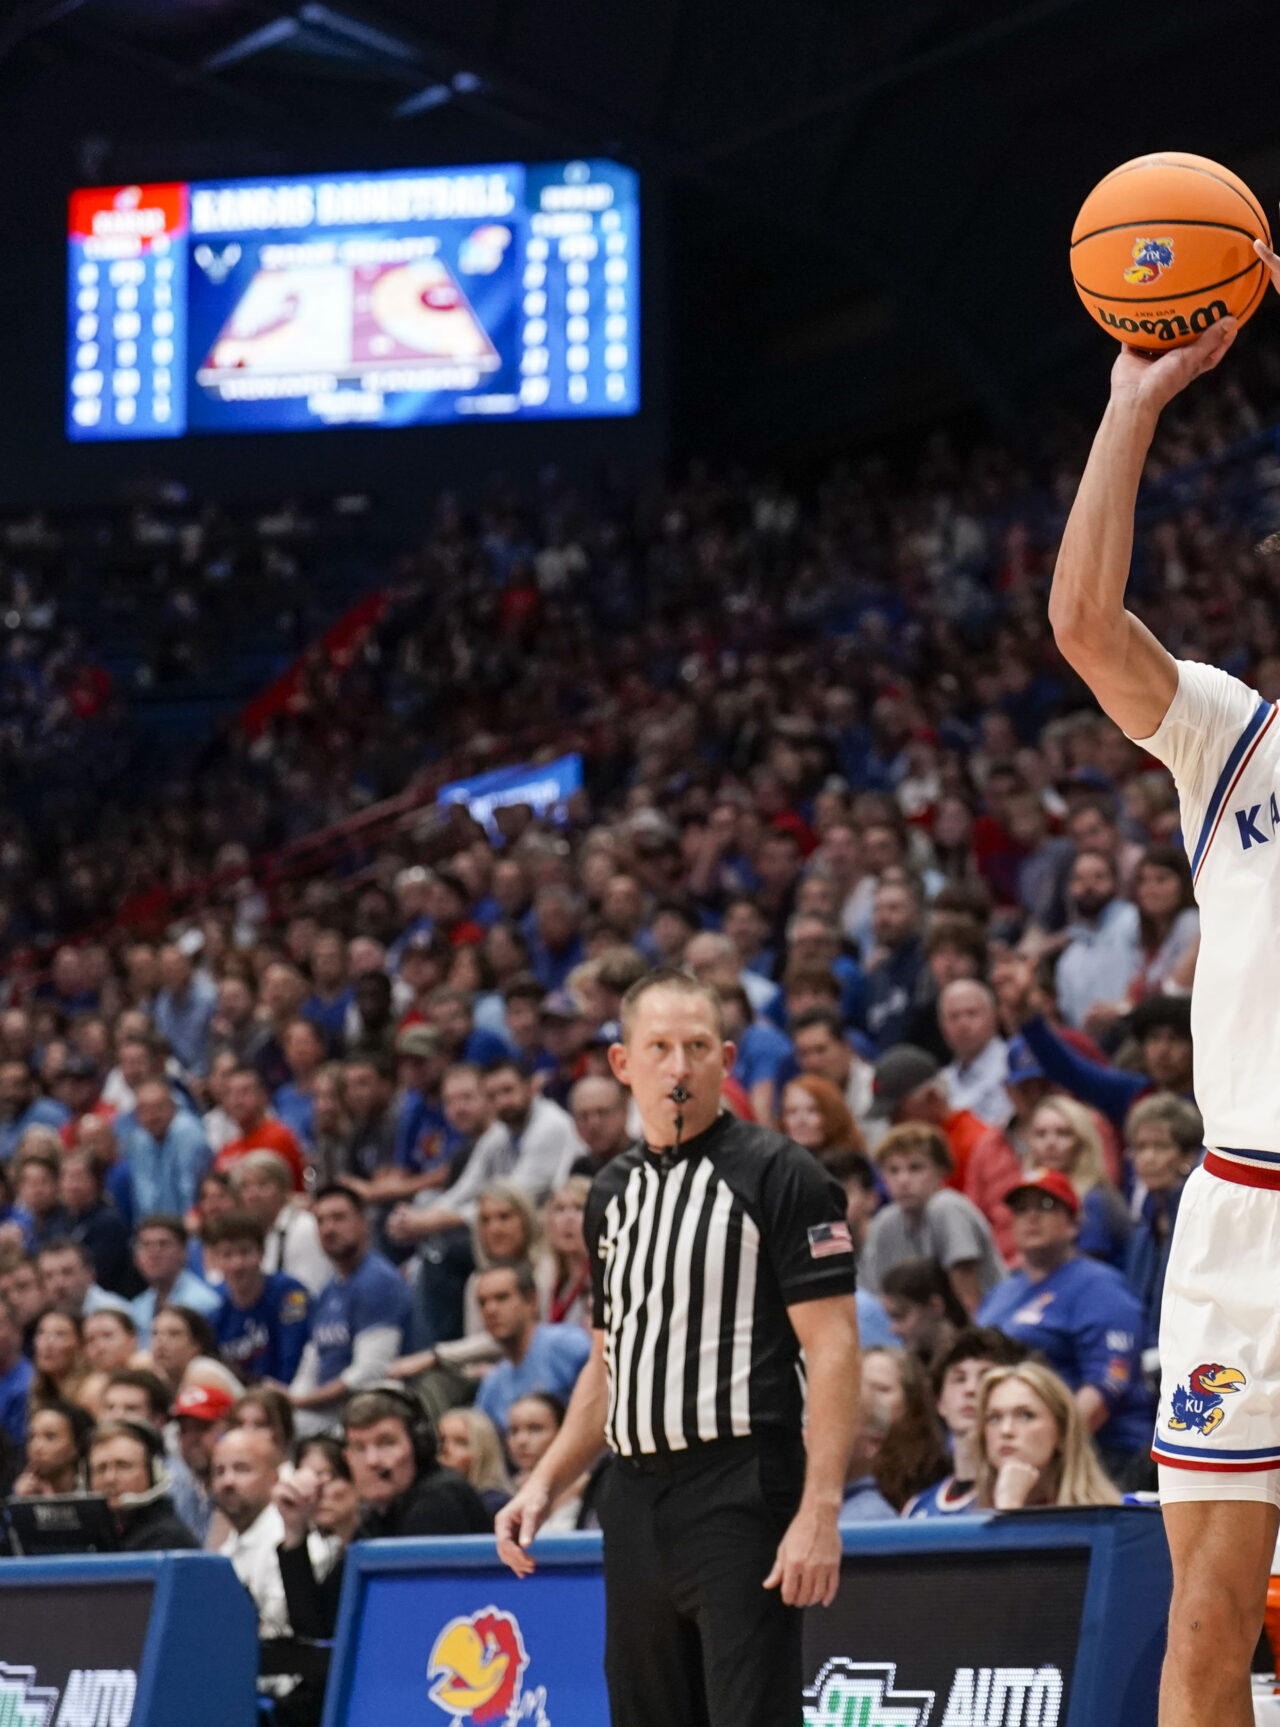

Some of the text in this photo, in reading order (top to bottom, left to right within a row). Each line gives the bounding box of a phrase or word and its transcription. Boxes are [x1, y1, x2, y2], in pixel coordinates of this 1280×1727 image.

[1097, 300, 1234, 341] Wilson
[1185, 1399, 1204, 1414] KU
[54, 1669, 138, 1727] AUTO
[940, 1667, 1064, 1727] AUTO
